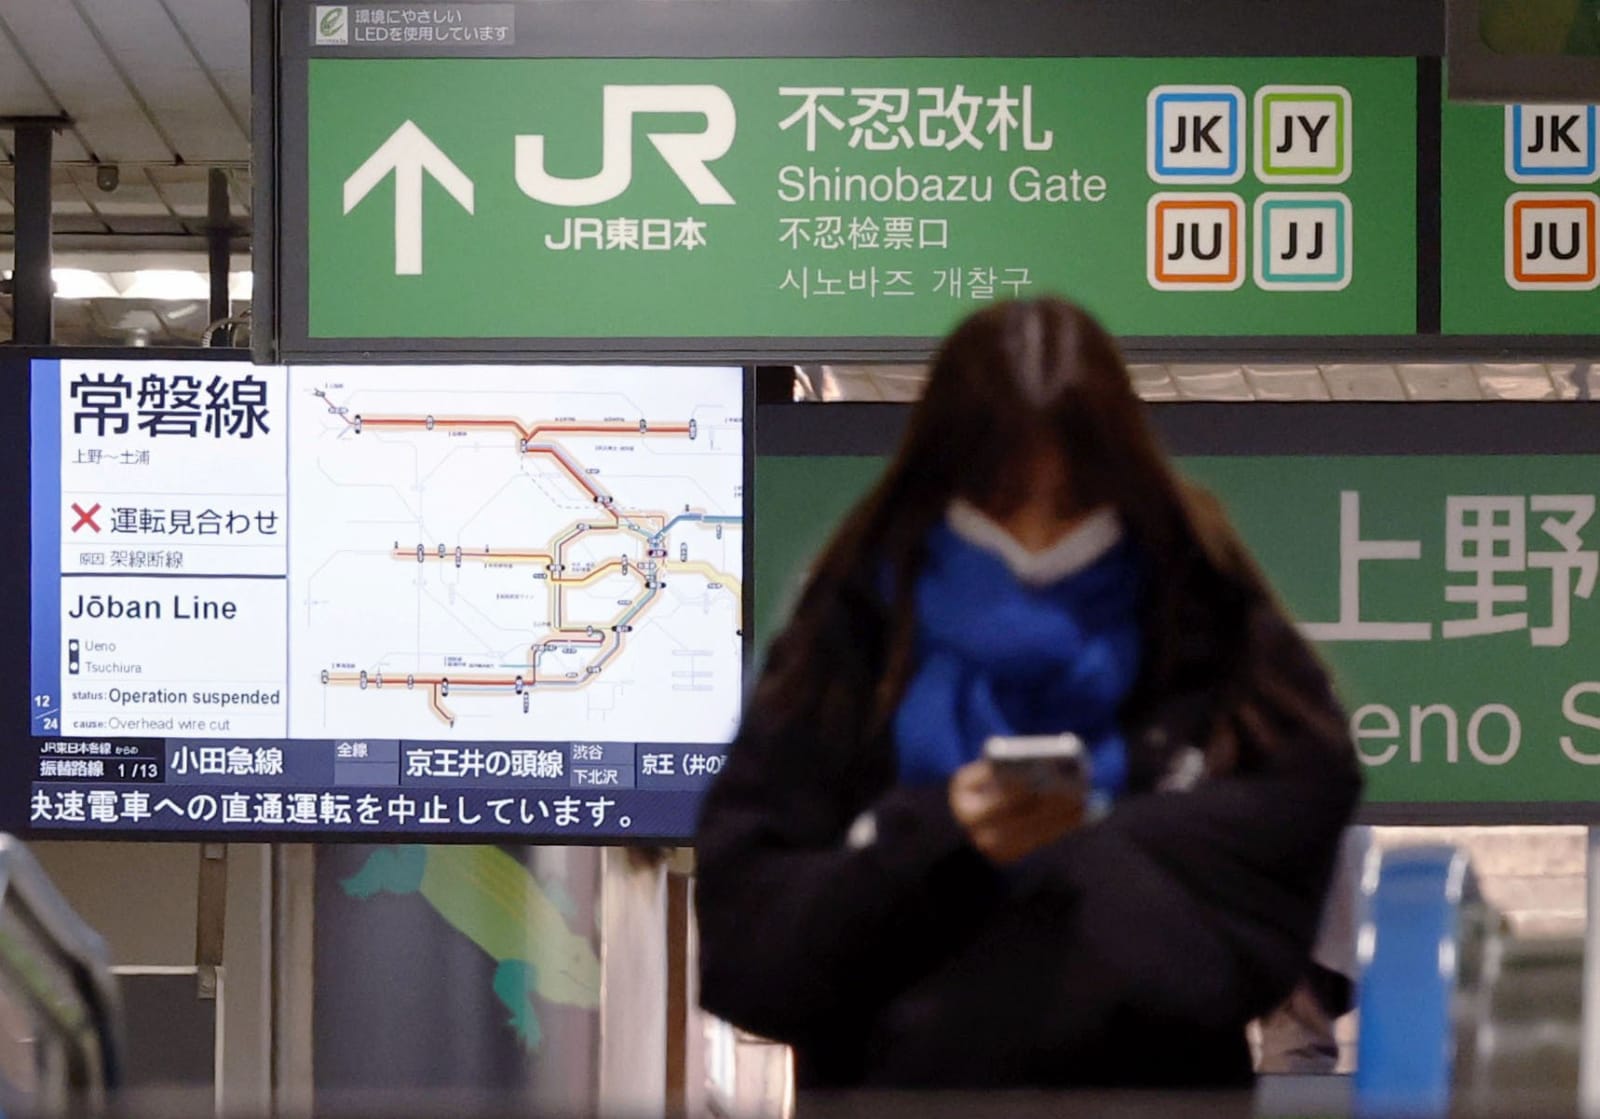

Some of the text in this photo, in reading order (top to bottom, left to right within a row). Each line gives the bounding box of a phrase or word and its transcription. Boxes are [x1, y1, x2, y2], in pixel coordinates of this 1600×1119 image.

[355, 9, 462, 24] 環境にやさしい
[355, 26, 509, 42] LEDを使用しています
[778, 84, 1053, 152] 不忍改札
[514, 84, 737, 207] JR
[1169, 115, 1330, 153] JK JY
[1527, 115, 1581, 153] JK
[777, 165, 1107, 203] Shinobazu Gate
[544, 217, 707, 250] JR東日本
[778, 216, 949, 250] 不忍检票口
[1167, 222, 1324, 260] JU JJ
[1526, 222, 1581, 260] JU
[778, 265, 1034, 300] 시노바즈 개찰구
[69, 373, 271, 439] 常磐線
[110, 507, 280, 536] 運転見合わせ
[1298, 490, 1600, 647] 上野
[68, 594, 237, 620] Jōban Line
[85, 640, 117, 653] Ueno
[85, 661, 143, 674] Tsuchiura
[34, 695, 51, 708] 12
[71, 688, 281, 707] status: Operation suspended
[43, 717, 59, 731] 24
[73, 717, 231, 732] cause: Overhead wire cut
[1351, 703, 1522, 766] eno
[171, 746, 284, 776] 小田急線
[336, 742, 368, 759] 全線
[405, 749, 564, 779] 京王井の頭線
[572, 744, 604, 761] 渋谷
[40, 760, 105, 777] 振替路線
[573, 769, 618, 785] 下北沢
